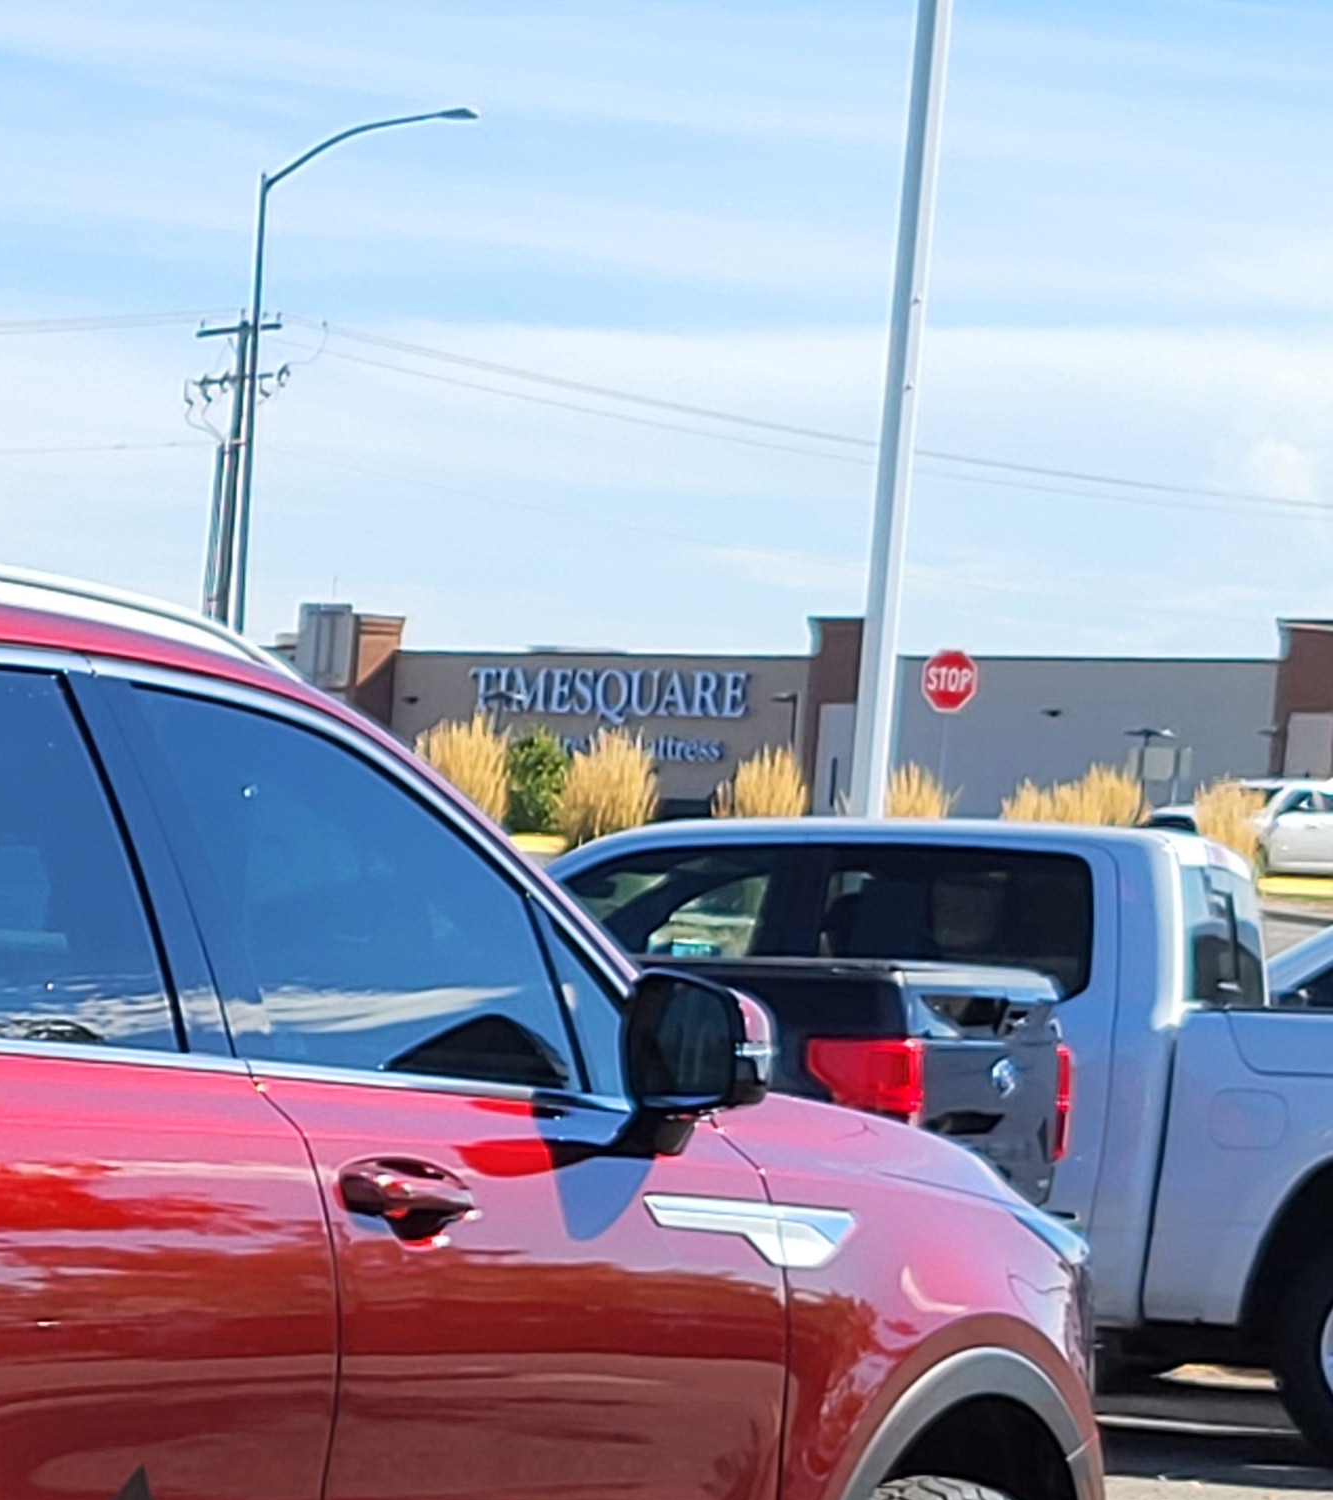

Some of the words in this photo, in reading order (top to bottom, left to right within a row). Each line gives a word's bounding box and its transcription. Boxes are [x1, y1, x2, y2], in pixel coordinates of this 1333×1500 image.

[926, 666, 973, 692] STOP
[469, 666, 750, 725] TIMESQUARE
[644, 732, 723, 762] attress
